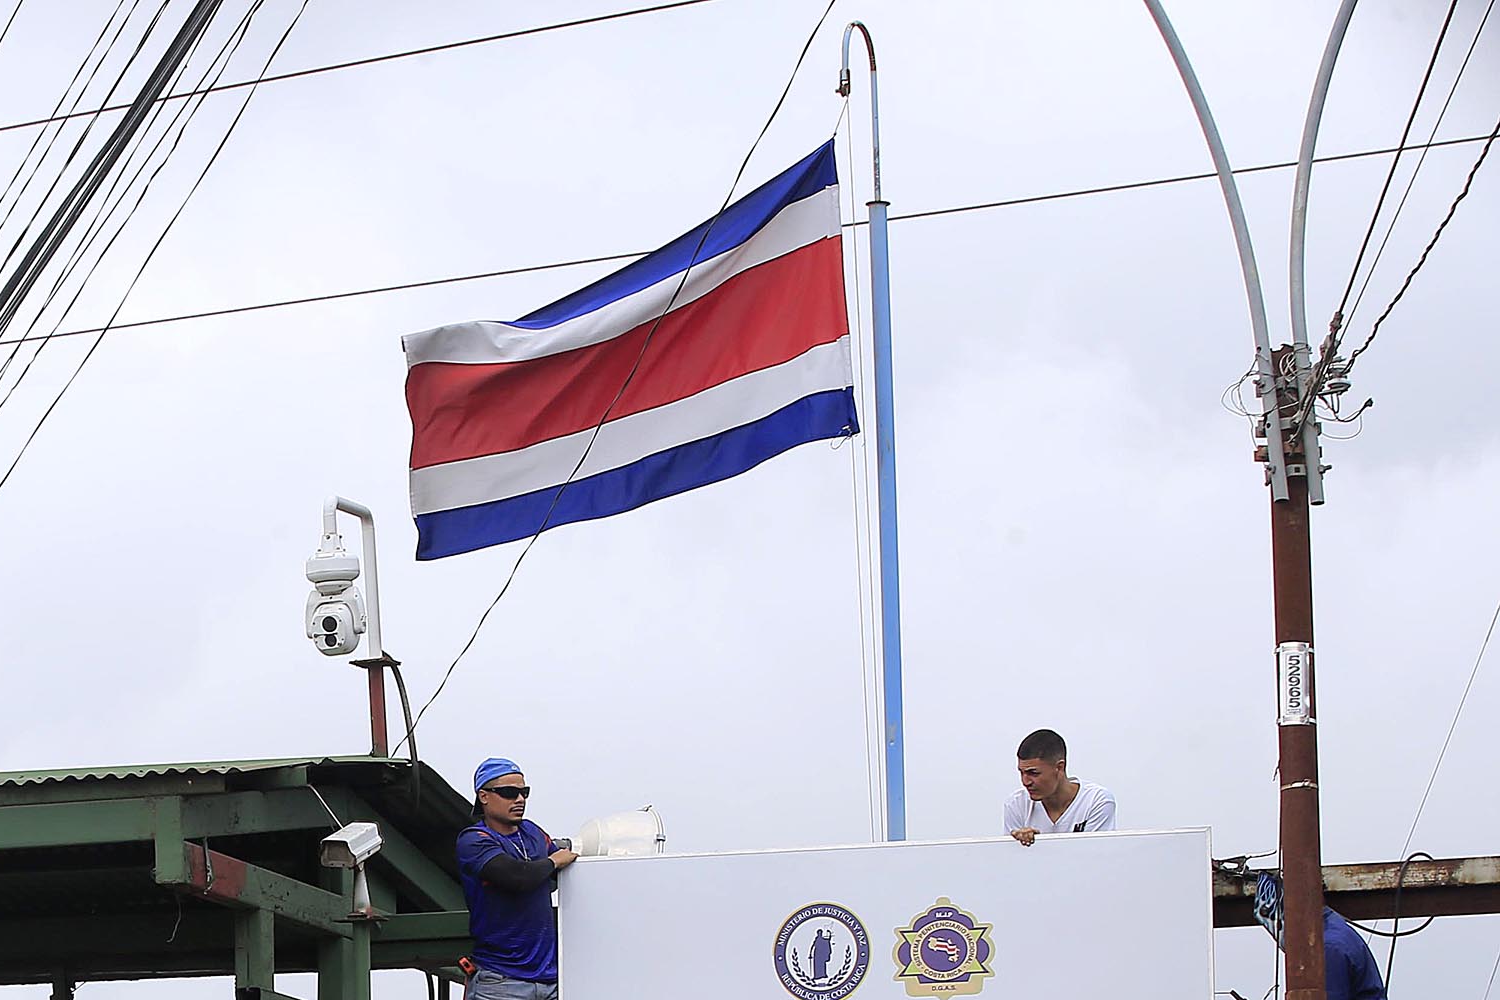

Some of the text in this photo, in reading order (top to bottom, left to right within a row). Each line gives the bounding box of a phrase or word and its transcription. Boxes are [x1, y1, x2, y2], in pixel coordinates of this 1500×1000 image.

[1288, 655, 1301, 708] 52965
[777, 909, 811, 946] MINISTERIO
[812, 907, 823, 915] DE
[824, 907, 854, 926] JUSTICIA
[857, 930, 867, 946] PAZ
[913, 922, 976, 968] SISTEMA PENITENCIARIO NACIONAL
[781, 964, 866, 1000] REPÚBLICA DE COSTA RICA
[924, 969, 963, 979] COSTA RICA
